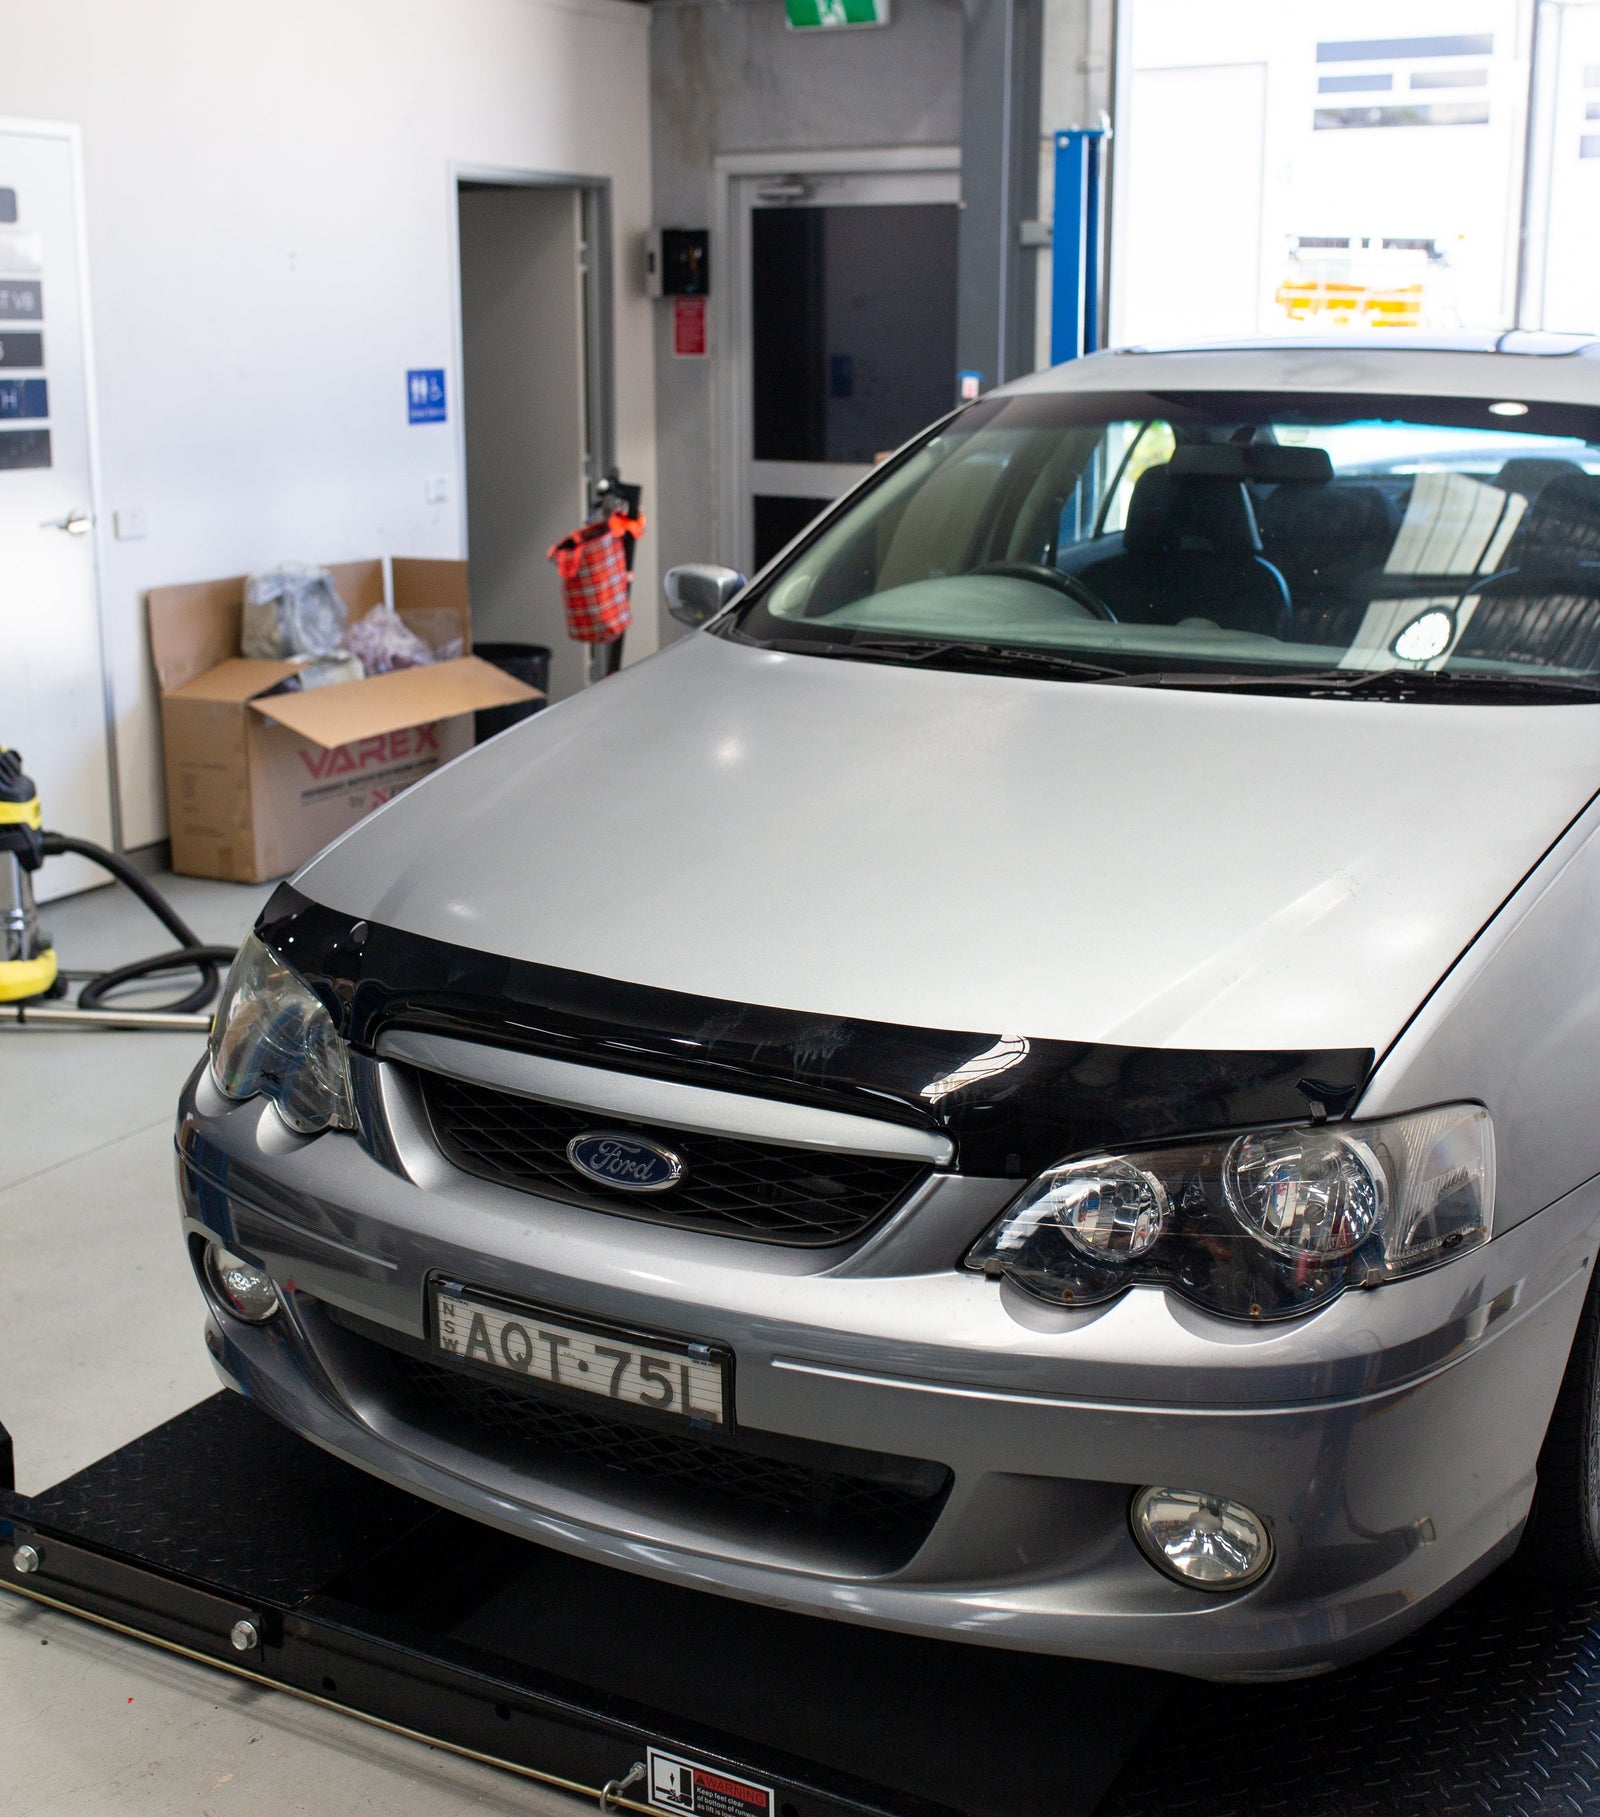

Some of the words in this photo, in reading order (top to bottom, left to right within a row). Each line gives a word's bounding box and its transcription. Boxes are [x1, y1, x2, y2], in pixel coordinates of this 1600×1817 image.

[298, 723, 440, 779] VAREX
[590, 1140, 656, 1180] Ford
[696, 1786, 714, 1798] Keep
[714, 1792, 727, 1802] feet
[727, 1798, 744, 1808] clear
[704, 1797, 727, 1810] bottom
[706, 1775, 765, 1806] WARNING
[705, 1805, 715, 1814] lift
